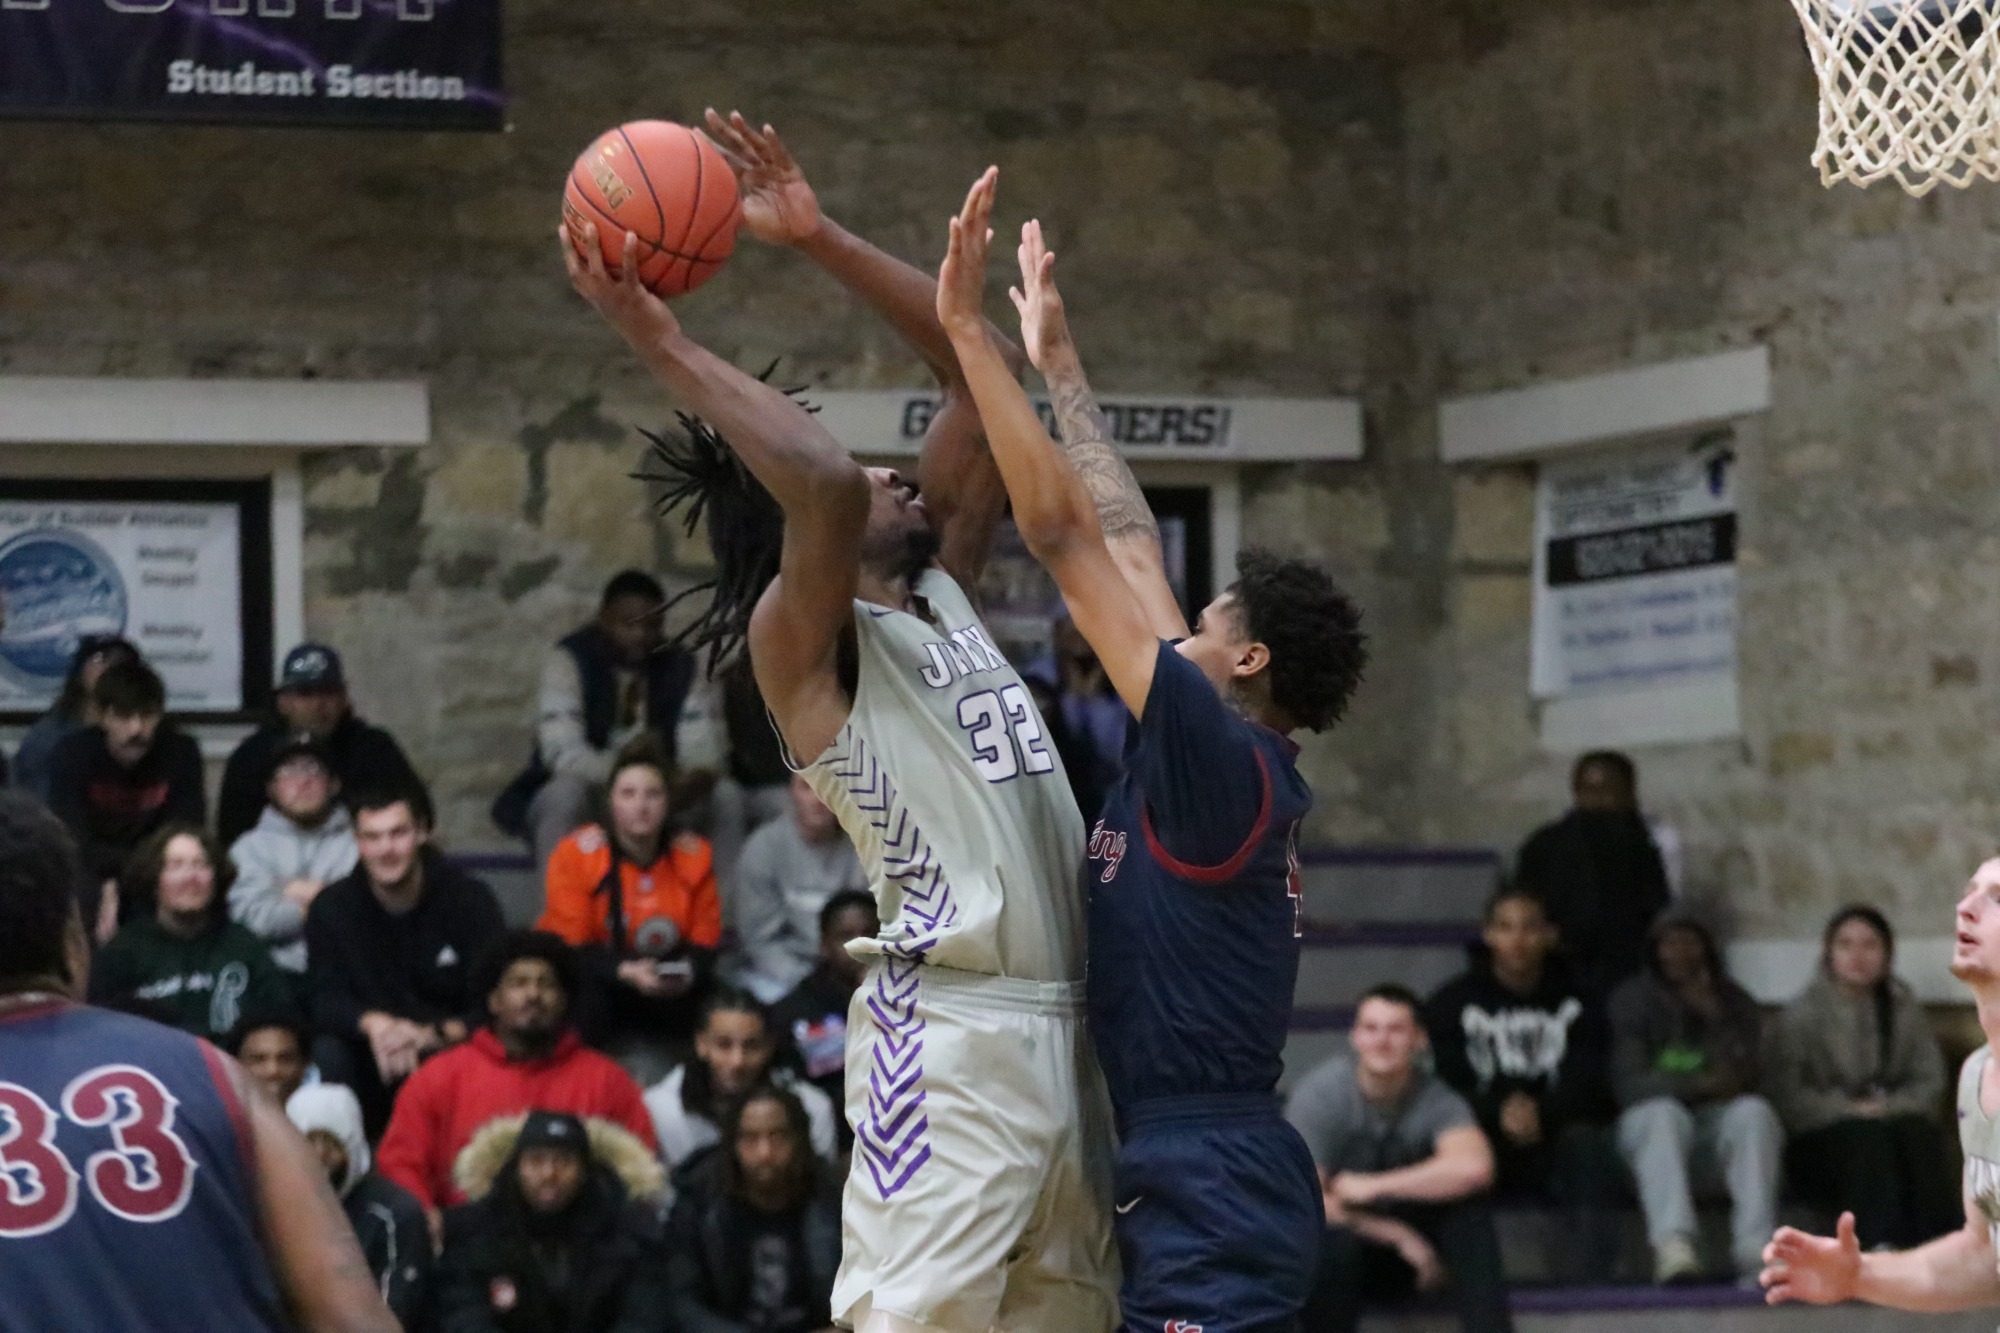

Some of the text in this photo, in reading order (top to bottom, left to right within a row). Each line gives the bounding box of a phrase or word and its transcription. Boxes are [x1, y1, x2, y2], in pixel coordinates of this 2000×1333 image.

[168, 60, 465, 100] Student Section
[957, 682, 1054, 783] 32
[0, 1063, 199, 1238] 33
